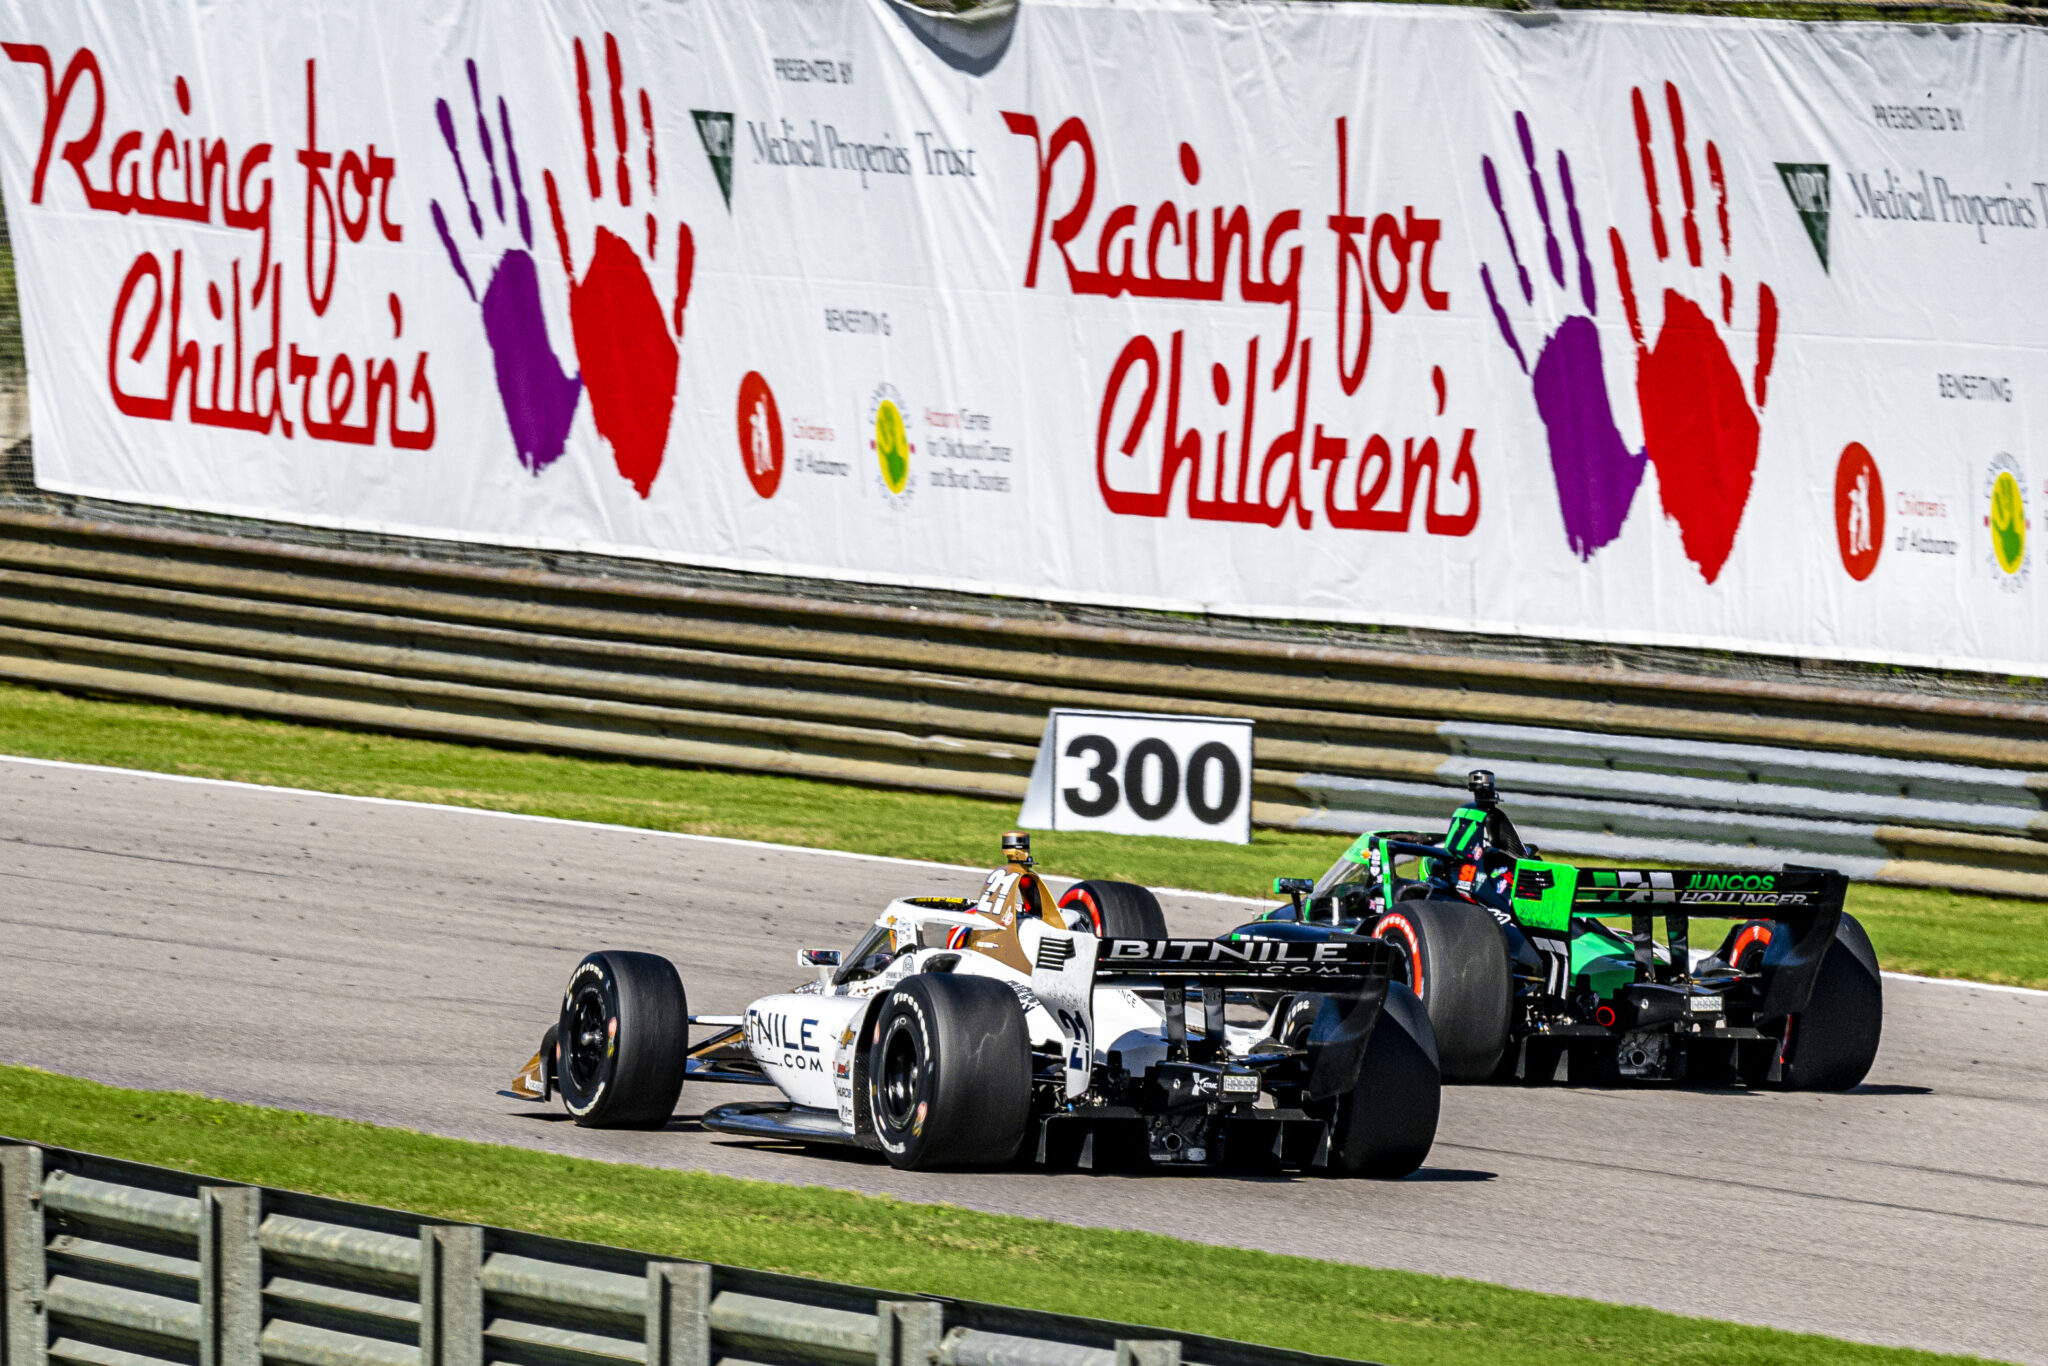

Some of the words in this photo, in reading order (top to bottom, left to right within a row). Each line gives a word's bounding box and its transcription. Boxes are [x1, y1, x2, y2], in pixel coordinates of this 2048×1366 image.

[0, 42, 272, 309] Racing
[296, 58, 402, 316] for
[747, 117, 825, 168] Medical
[823, 124, 912, 189] Properties
[914, 131, 976, 176] Trust
[1846, 168, 1936, 222] Medical
[1932, 175, 2036, 244] Properties
[999, 110, 1305, 392] Racing
[1328, 115, 1449, 396] for
[108, 249, 435, 450] Children's
[1097, 329, 1480, 537] Children's
[1063, 734, 1241, 825] 300
[977, 868, 1020, 915] 21
[1681, 892, 1807, 904] HOLLINGER
[1685, 874, 1775, 890] JUNCOS
[1109, 940, 1348, 962] BITNILE
[746, 1009, 820, 1053] TNILE
